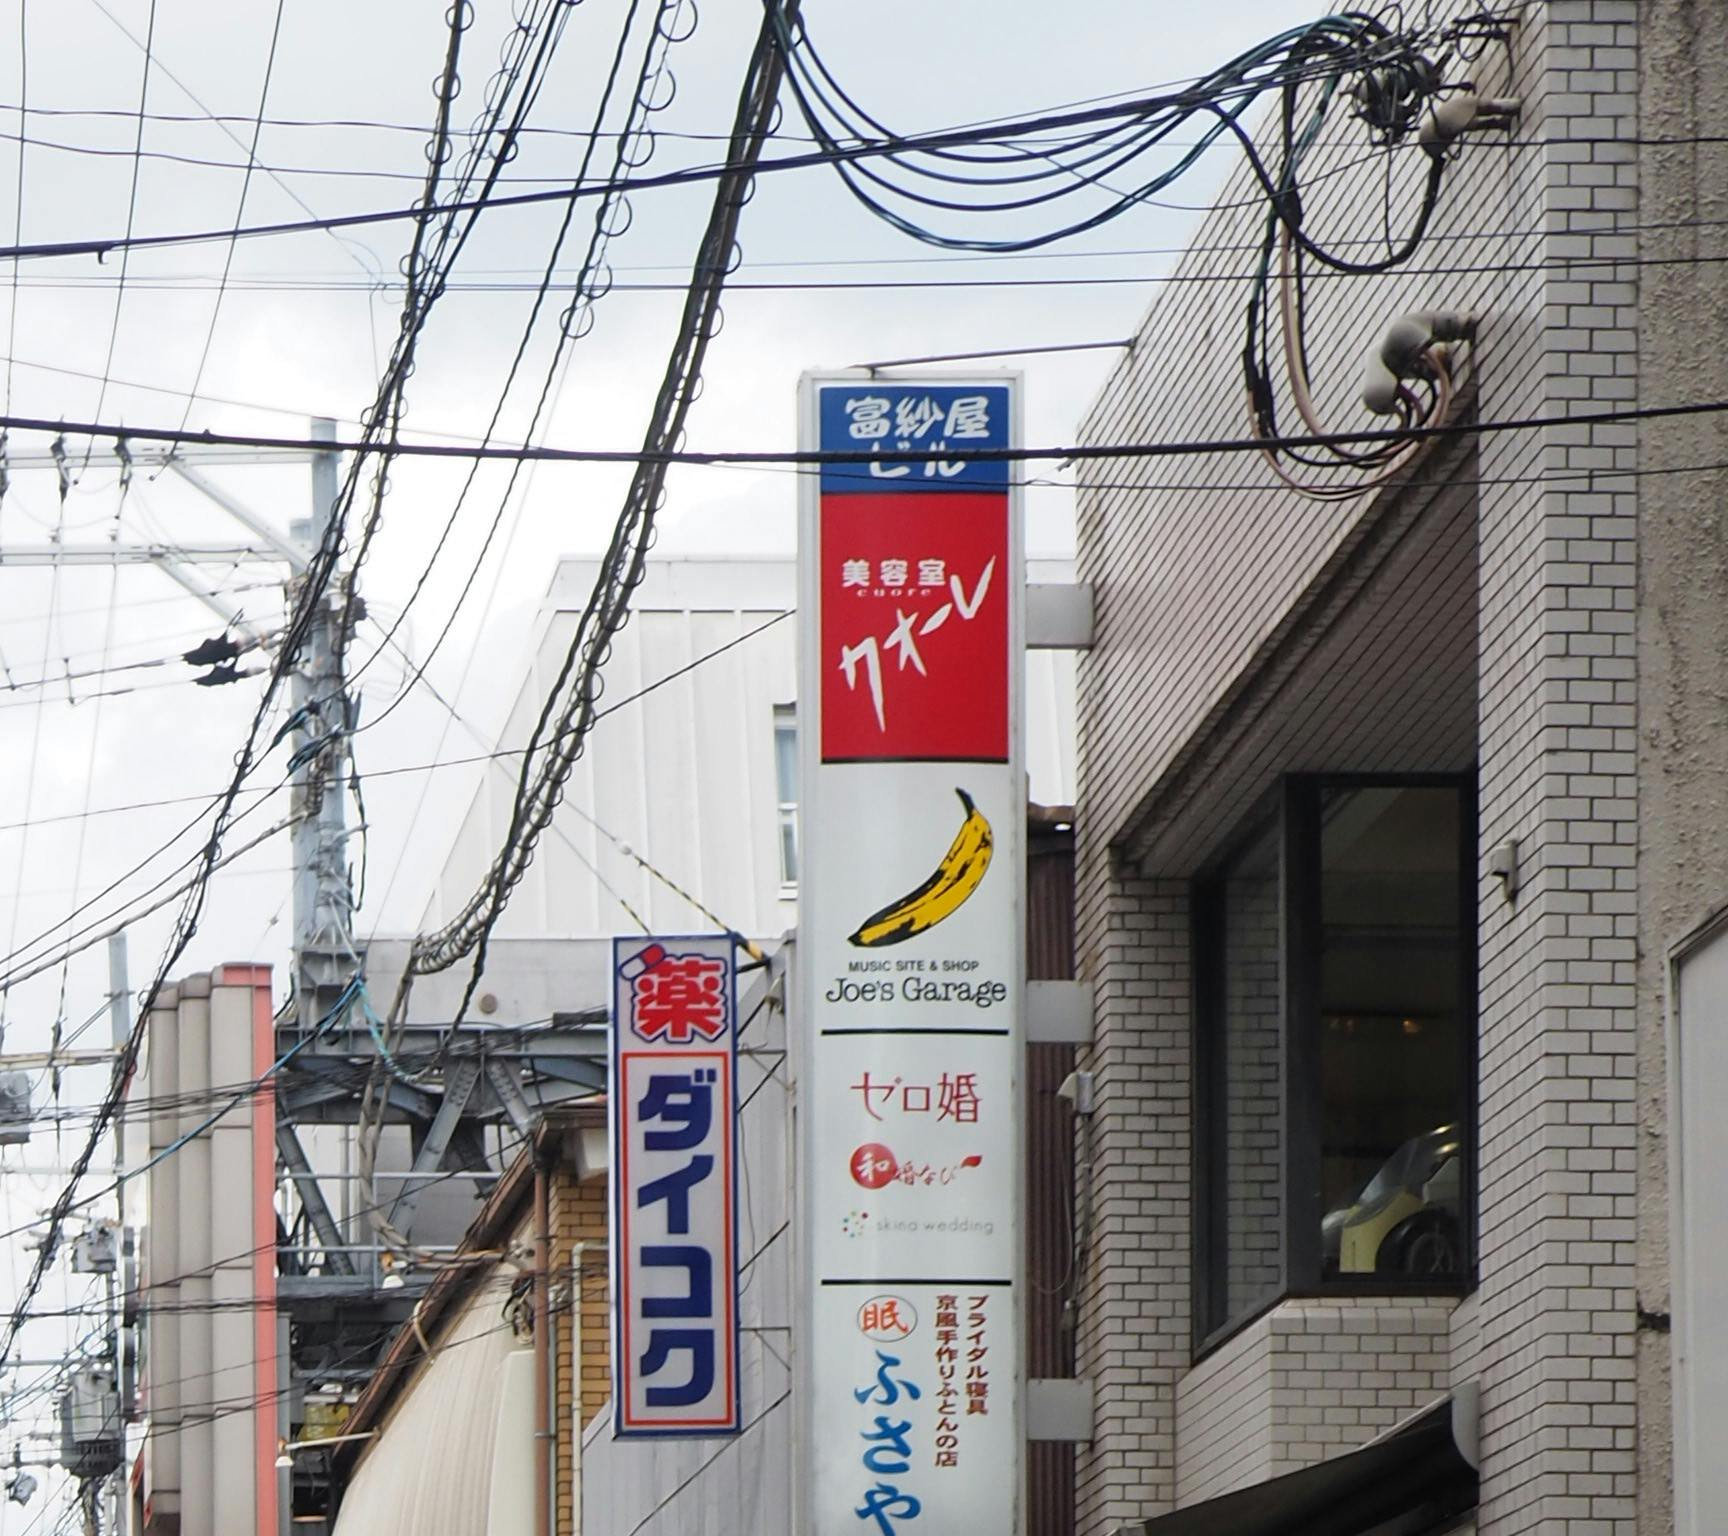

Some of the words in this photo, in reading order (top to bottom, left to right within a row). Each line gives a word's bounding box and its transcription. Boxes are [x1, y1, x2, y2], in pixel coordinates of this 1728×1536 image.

[844, 396, 990, 440] 富紗屋
[869, 441, 966, 478] ビル
[842, 558, 946, 588] 美容室
[838, 555, 997, 733] クオーレ
[848, 960, 891, 973] MUSIC
[896, 960, 927, 972] SITE
[930, 959, 939, 972] &
[943, 960, 980, 972] SHOP
[634, 955, 728, 1042] 薬
[827, 977, 897, 1004] Joe's
[903, 977, 1007, 1009] Garage
[850, 1072, 981, 1123] ゼロ婚
[637, 1069, 718, 1408] ダイコク
[924, 1216, 994, 1236] wedding
[862, 1301, 909, 1334] 眠
[966, 1295, 990, 1416] ブライダル寝具
[935, 1295, 959, 1467] 京風手作りふとんの店
